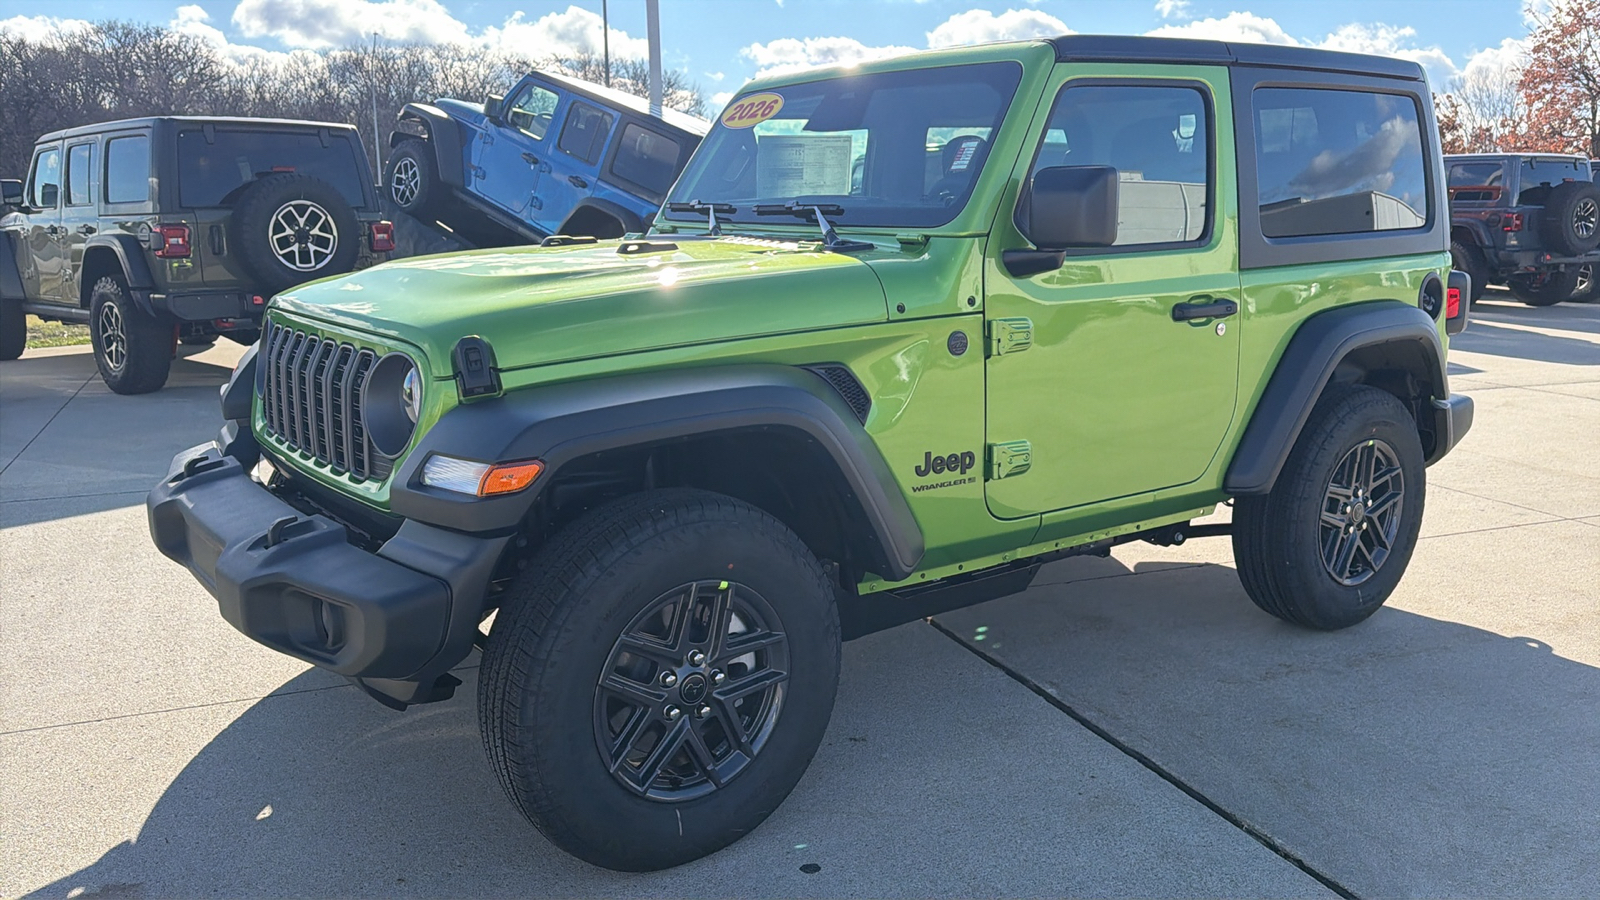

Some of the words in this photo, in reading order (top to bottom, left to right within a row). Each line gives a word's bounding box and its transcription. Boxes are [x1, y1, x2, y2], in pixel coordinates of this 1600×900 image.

[725, 99, 779, 122] 2026
[915, 451, 975, 477] Jeep
[912, 479, 966, 493] WRANGLER
